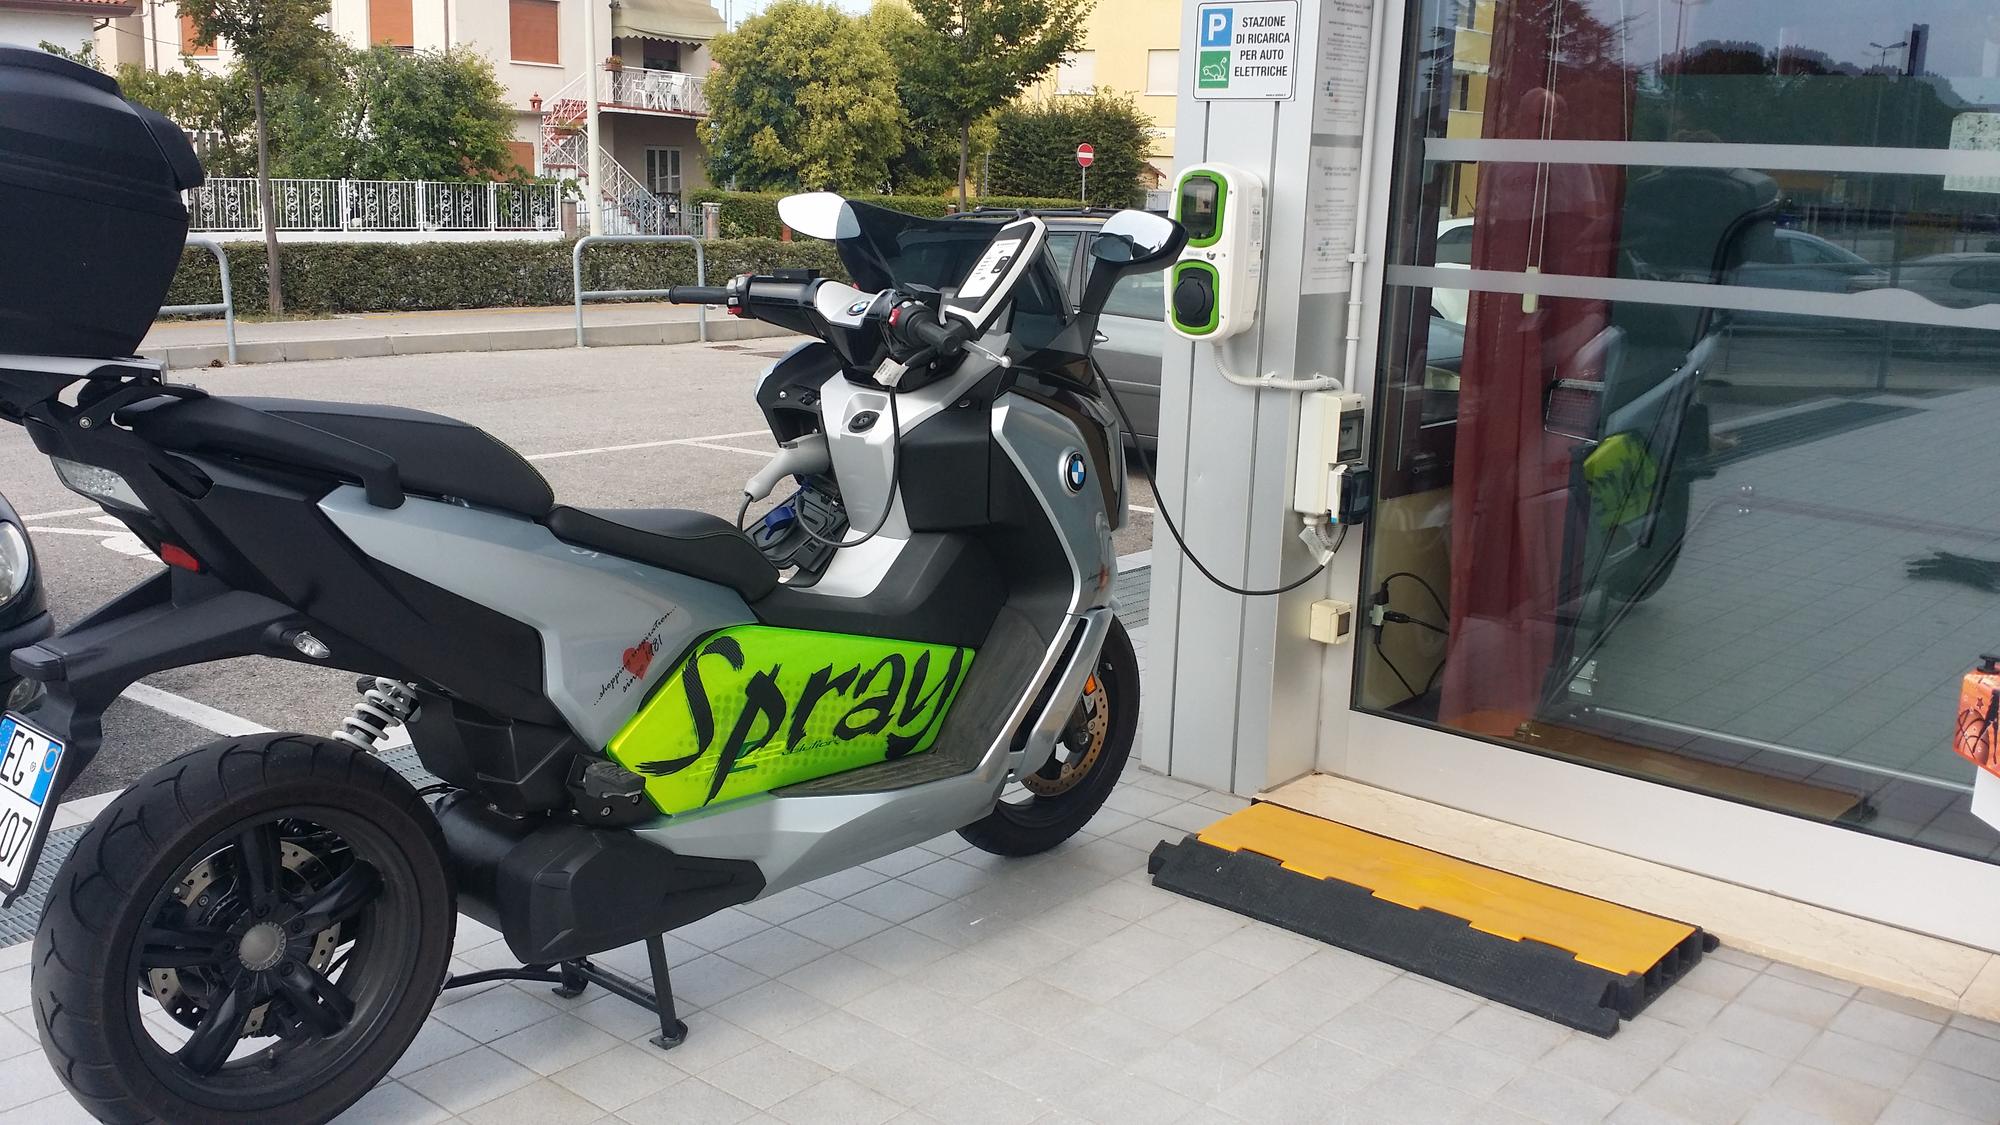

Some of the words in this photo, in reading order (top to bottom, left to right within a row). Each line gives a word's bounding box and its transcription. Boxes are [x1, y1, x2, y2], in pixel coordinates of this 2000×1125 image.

[1208, 13, 1227, 41] P
[1242, 16, 1286, 28] STAZIONE
[1236, 33, 1245, 44] DI
[1247, 32, 1290, 44] RICARICA
[1240, 49, 1257, 60] PER
[1259, 49, 1284, 60] AUTO
[1234, 65, 1288, 77] ELETTRICHE
[635, 636, 964, 807] Spray
[0, 807, 33, 868] 07
